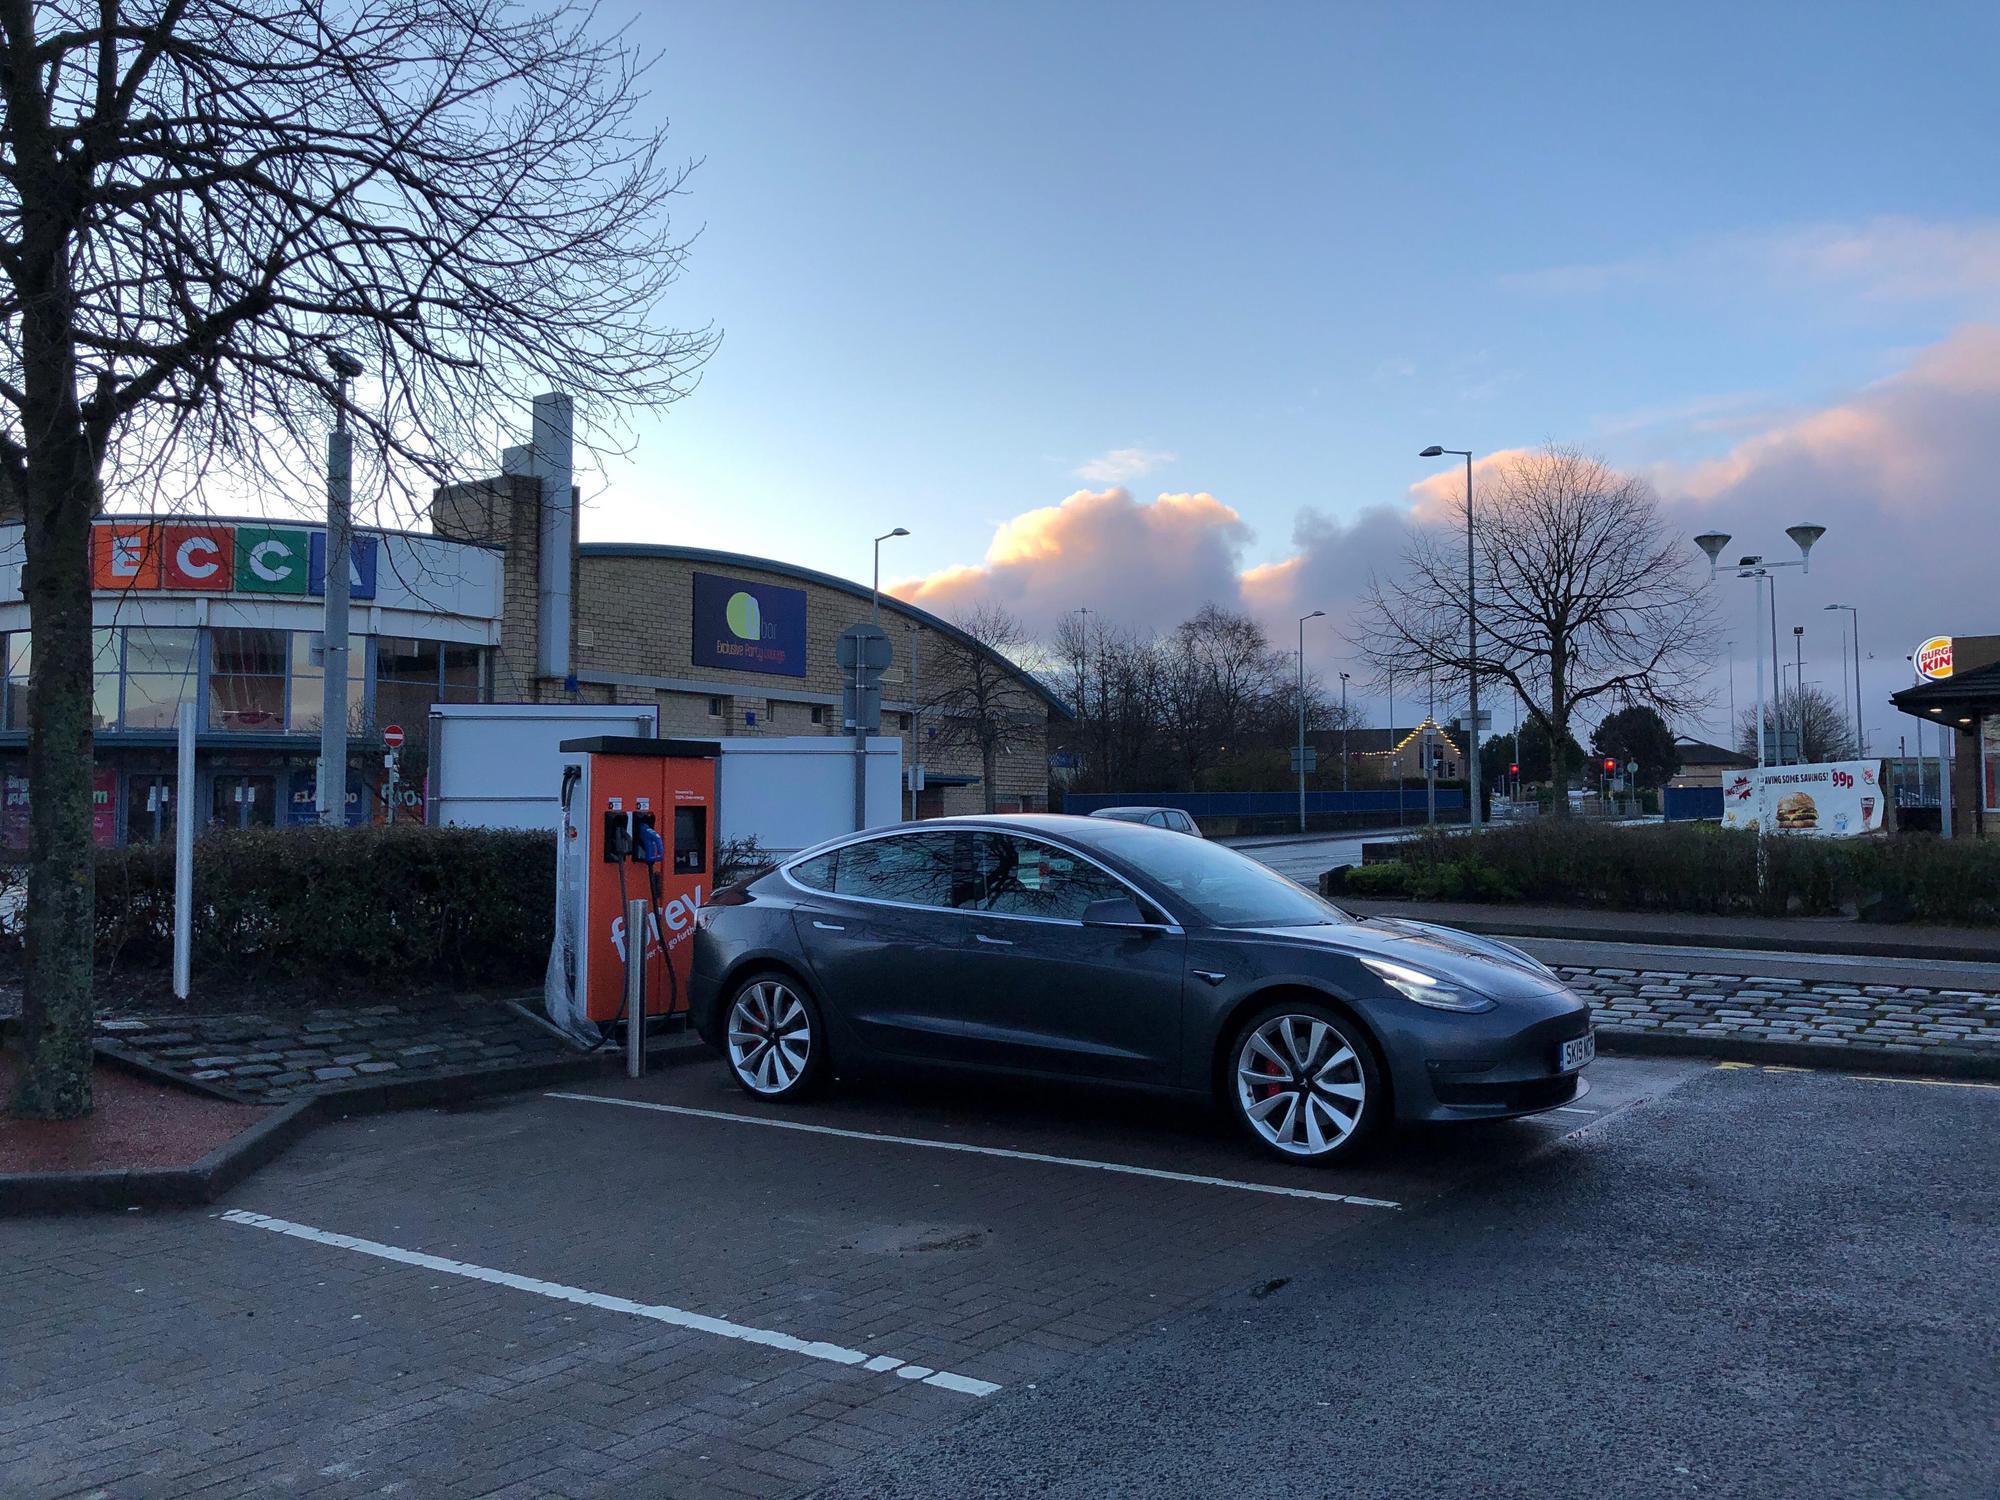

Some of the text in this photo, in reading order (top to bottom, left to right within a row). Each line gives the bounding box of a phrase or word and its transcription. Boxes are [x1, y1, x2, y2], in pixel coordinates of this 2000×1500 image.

[1923, 655, 1951, 673] KIN
[1782, 774, 1800, 784] SOME
[1832, 771, 1854, 789] 99p
[676, 925, 696, 942] furth
[1566, 1041, 1583, 1065] SK19
